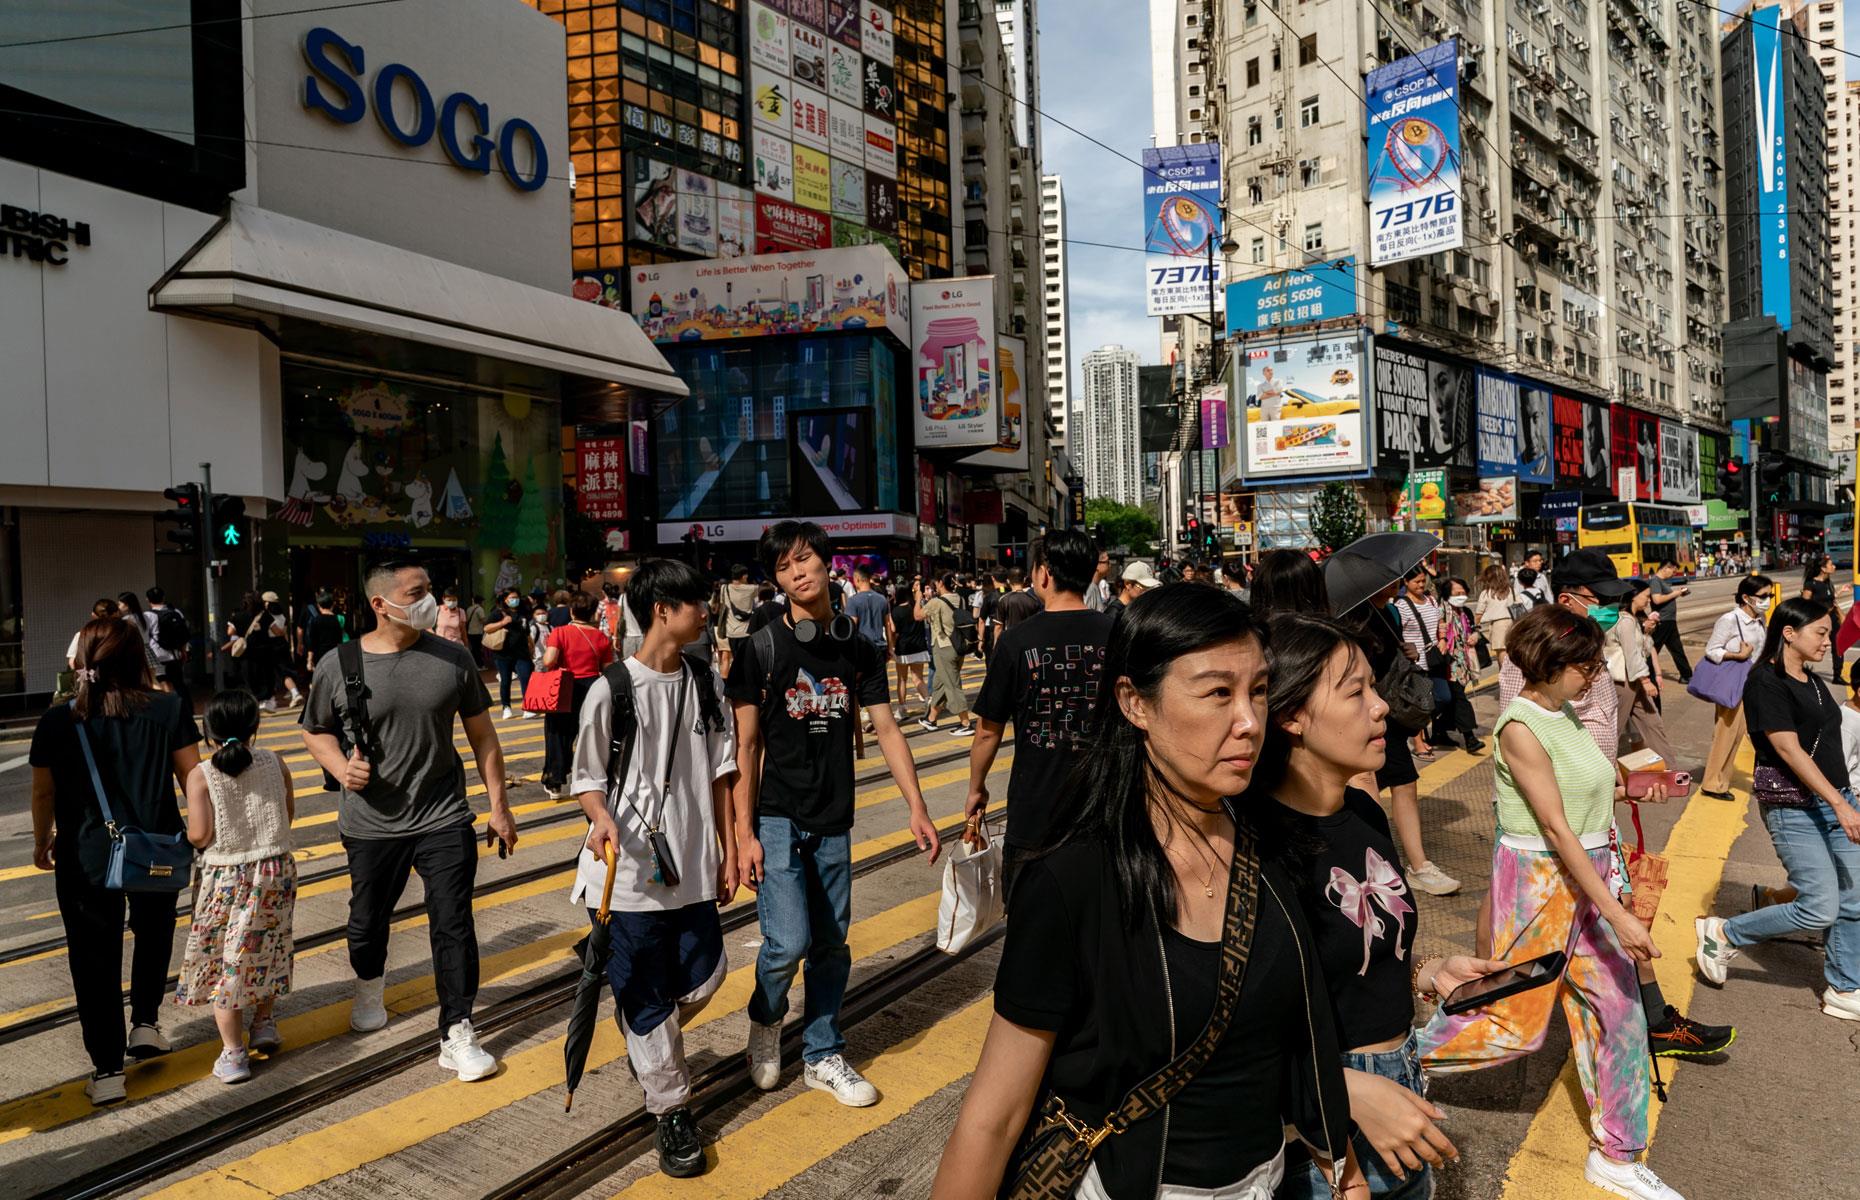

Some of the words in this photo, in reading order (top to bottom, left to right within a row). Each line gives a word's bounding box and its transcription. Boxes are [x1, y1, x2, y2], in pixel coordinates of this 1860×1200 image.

[1394, 78, 1424, 97] CSOP
[303, 27, 549, 192] SOGO
[1167, 166, 1194, 177] CSOP
[1776, 136, 1785, 191] 3602
[1375, 190, 1455, 230] 7376
[1376, 214, 1457, 243] 南方東英比特幣期貨
[1777, 203, 1787, 260] 2388
[648, 272, 660, 281] LG
[696, 269, 712, 278] Life
[722, 266, 748, 275] Better
[750, 263, 775, 273] When
[777, 260, 816, 271] Together
[1151, 264, 1220, 285] 7376
[1263, 276, 1281, 292] Ad
[1284, 273, 1314, 288] Here
[951, 290, 963, 298] LG
[1257, 293, 1287, 310] 9556
[1290, 286, 1322, 303] 5696
[1257, 302, 1323, 327] 廣告位招租
[1376, 346, 1406, 364] THERE'S
[1408, 355, 1426, 369] ONLY
[1376, 359, 1393, 394] ONE
[1393, 363, 1428, 400] SOUVENIR
[1382, 394, 1405, 412] WANT
[1406, 398, 1428, 417] FROM
[1478, 374, 1516, 420] AMBITION
[1383, 411, 1424, 453] PARS.
[1478, 414, 1502, 434] NEEDS
[1504, 419, 1516, 436] NO
[584, 451, 618, 470] 麻辣
[585, 472, 618, 491] 派對
[707, 525, 724, 537] LG
[820, 523, 839, 532] ave
[842, 519, 886, 533] Optimism
